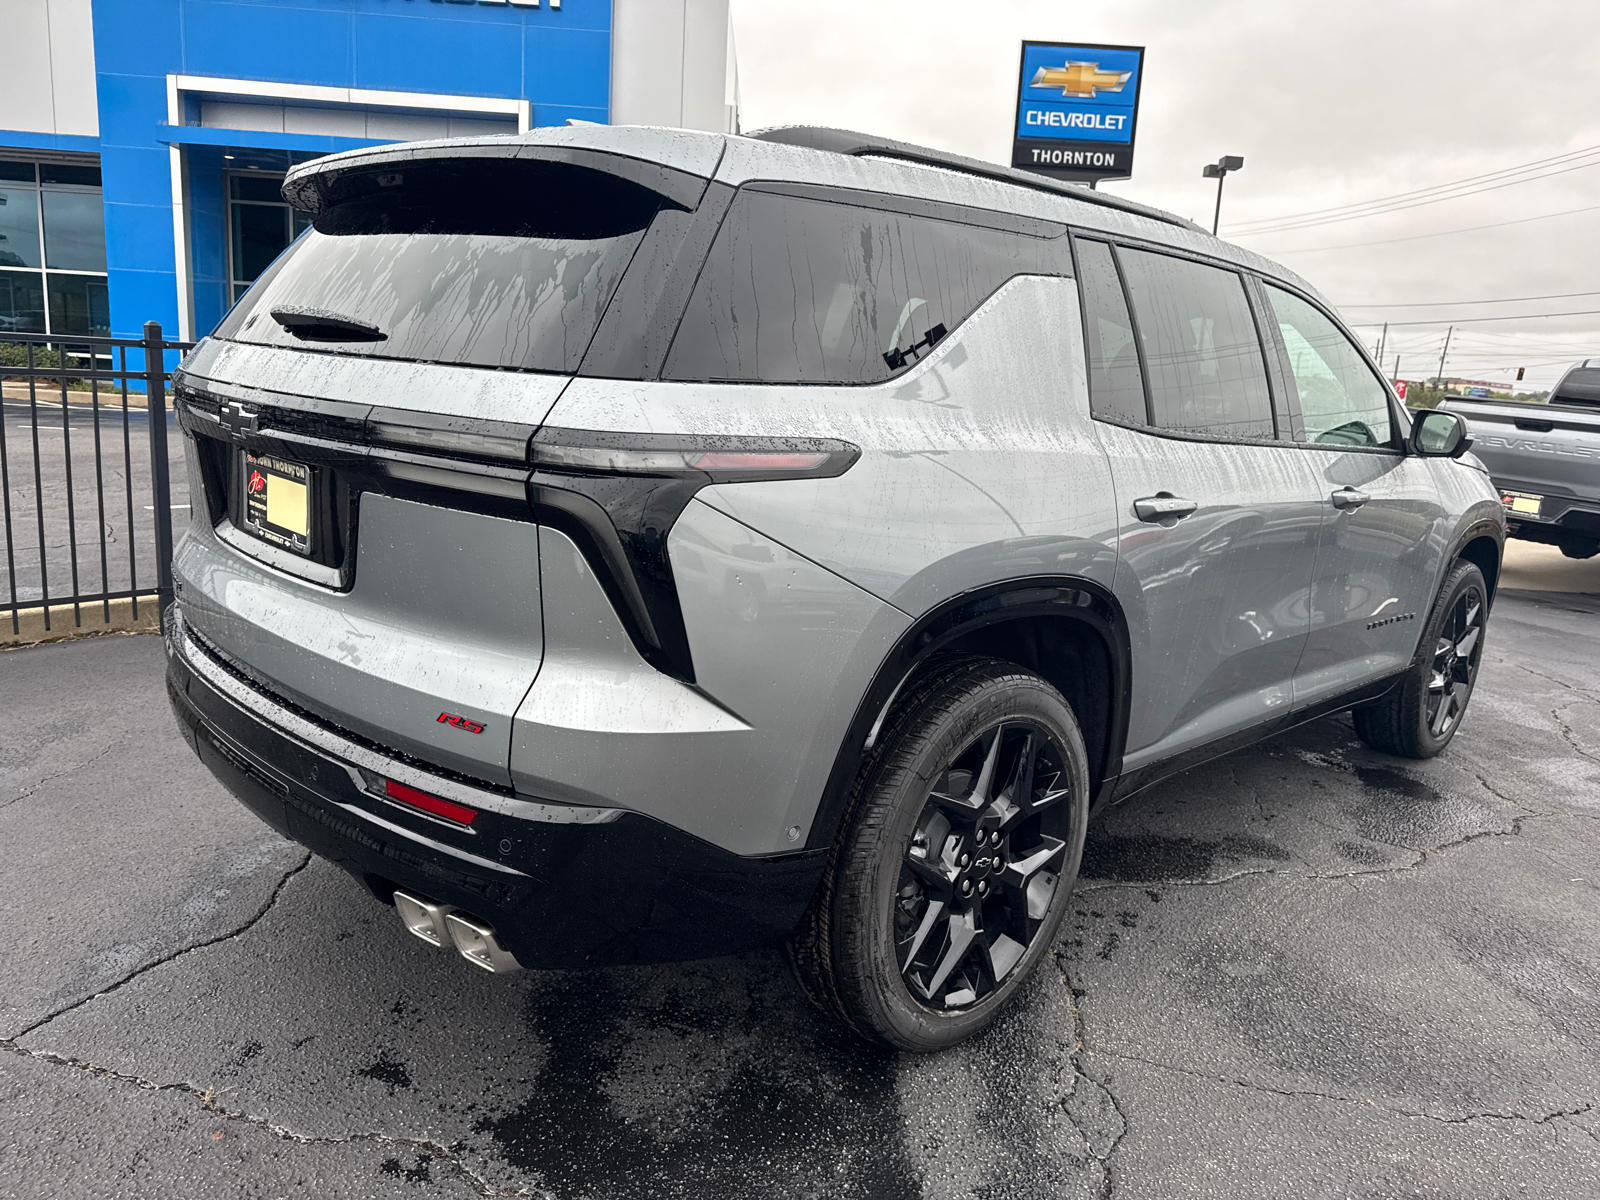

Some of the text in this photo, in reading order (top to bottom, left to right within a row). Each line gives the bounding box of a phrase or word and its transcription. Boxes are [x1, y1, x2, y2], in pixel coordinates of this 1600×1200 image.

[1026, 110, 1127, 130] CHEVROLET
[1031, 149, 1115, 167] THORNTON
[257, 456, 305, 478] JOHN THORNTON
[436, 711, 487, 734] RS
